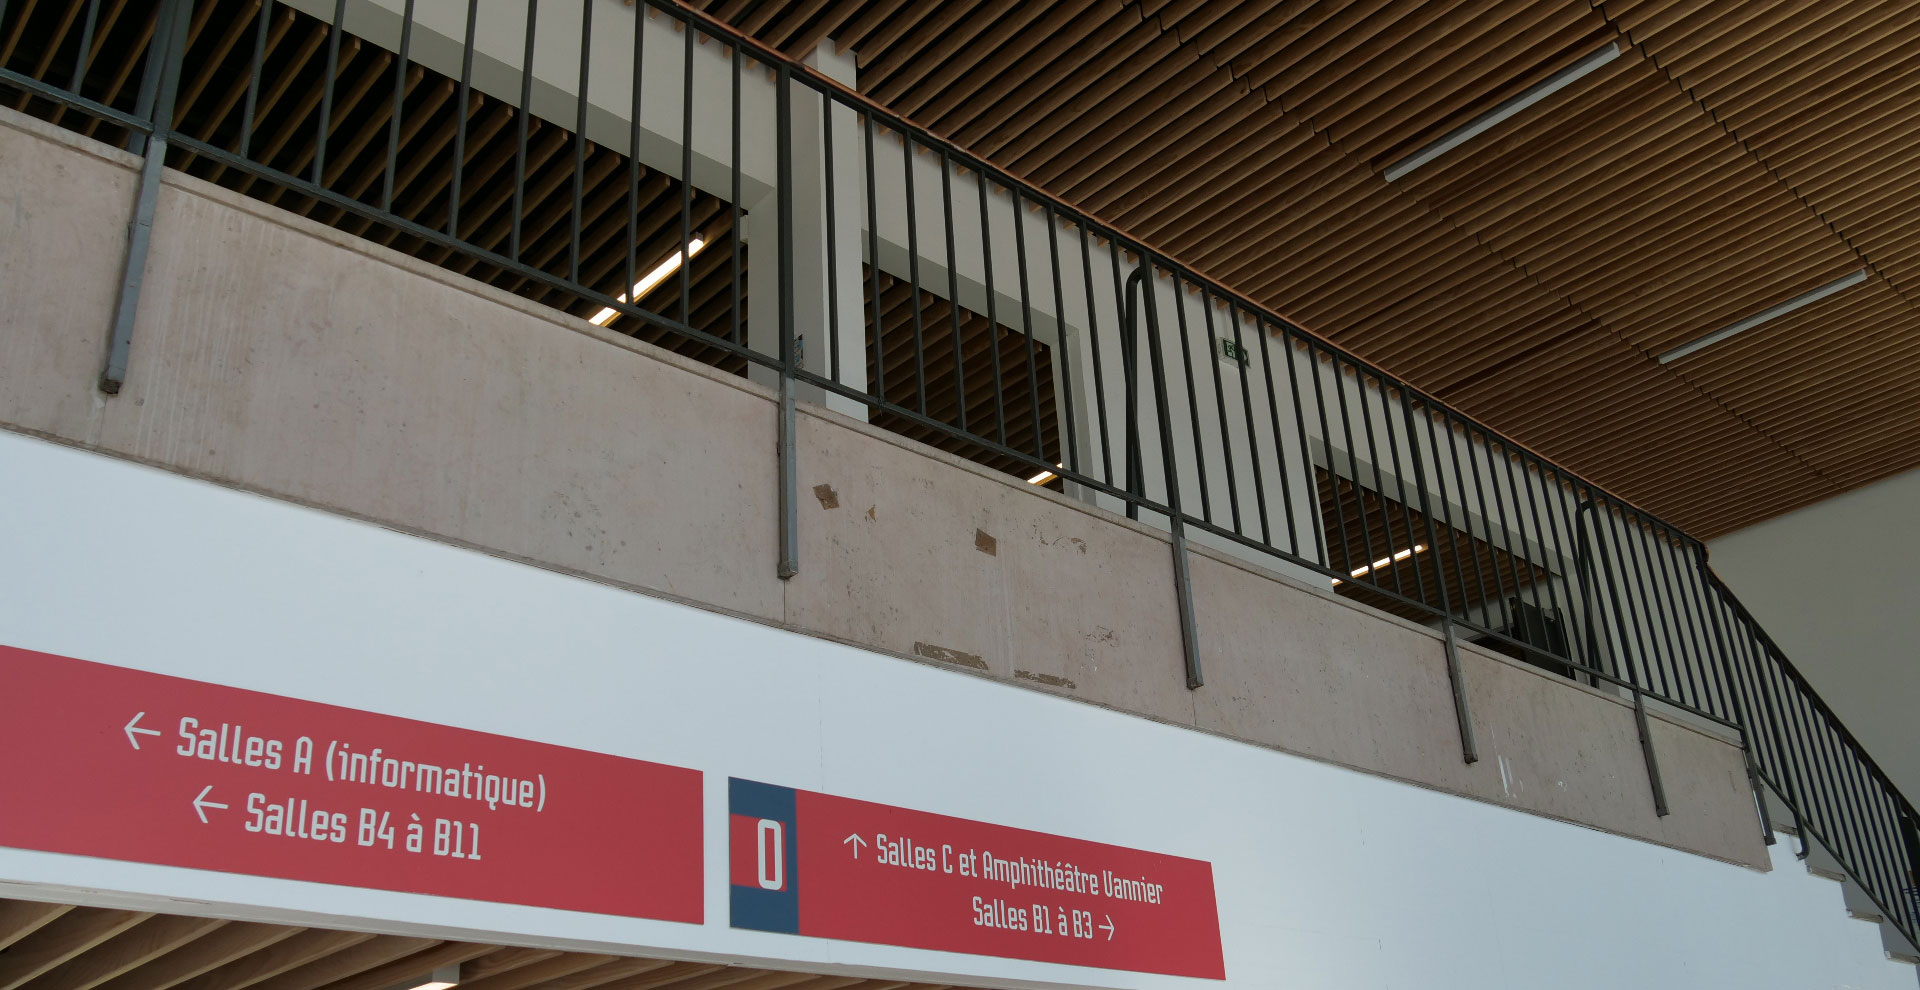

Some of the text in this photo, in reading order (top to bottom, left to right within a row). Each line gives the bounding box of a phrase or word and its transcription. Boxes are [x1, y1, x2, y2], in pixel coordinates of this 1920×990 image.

[176, 717, 546, 813] Salles A (informatique)
[244, 792, 482, 861] Salles B4 à B11
[876, 833, 1164, 905] Salles C et Amphithéâtre Vannier
[972, 895, 1093, 940] Salles B1 à B3
